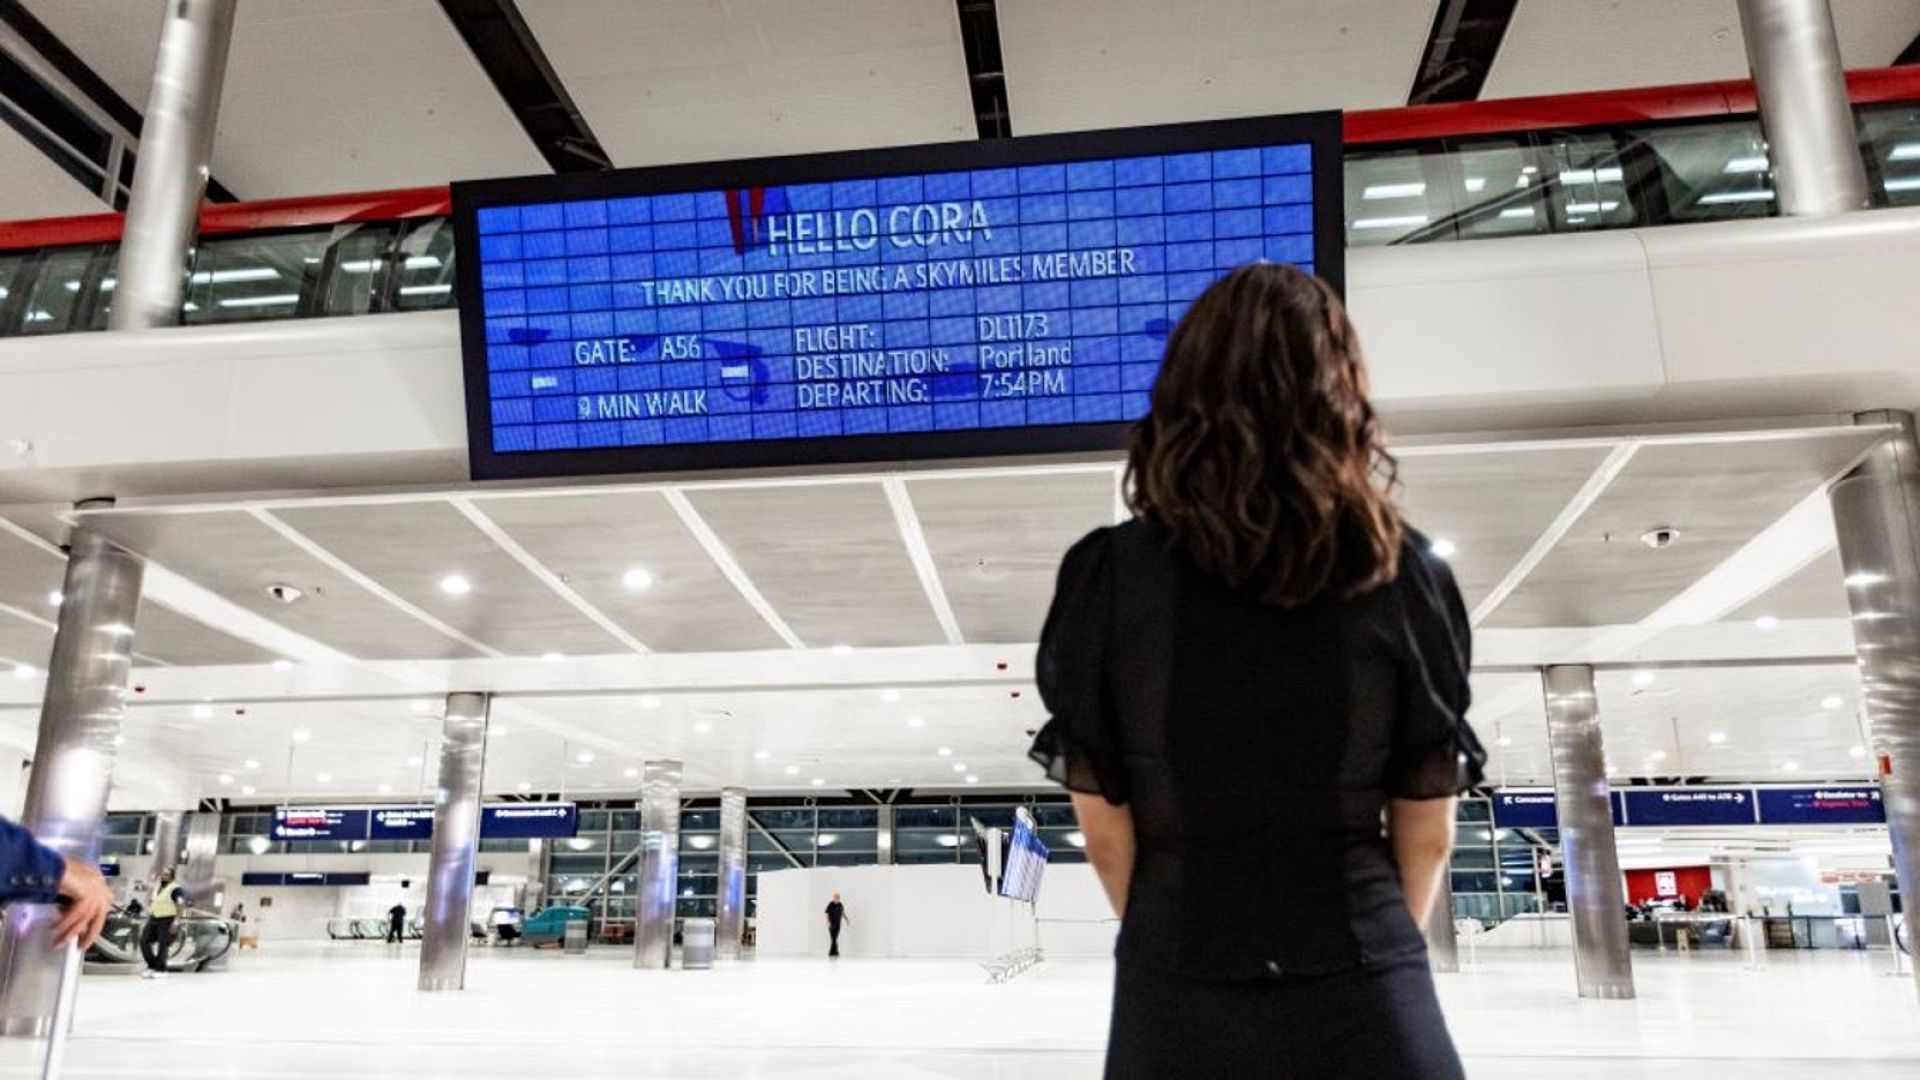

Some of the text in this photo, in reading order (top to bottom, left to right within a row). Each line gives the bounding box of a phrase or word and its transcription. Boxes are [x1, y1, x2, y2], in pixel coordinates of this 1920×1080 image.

[767, 200, 992, 256] HELLO CORA
[641, 248, 1135, 306] THANK YOU FOR BEING A SKYMILES MEMBER
[574, 335, 700, 364] GATE: A56
[795, 313, 1048, 352] FLIGHT: DL1173
[798, 340, 1072, 379] DESTINATION: Portland
[598, 396, 641, 419] MIN
[647, 391, 708, 415] WALK
[798, 377, 929, 408] DEPARTING:
